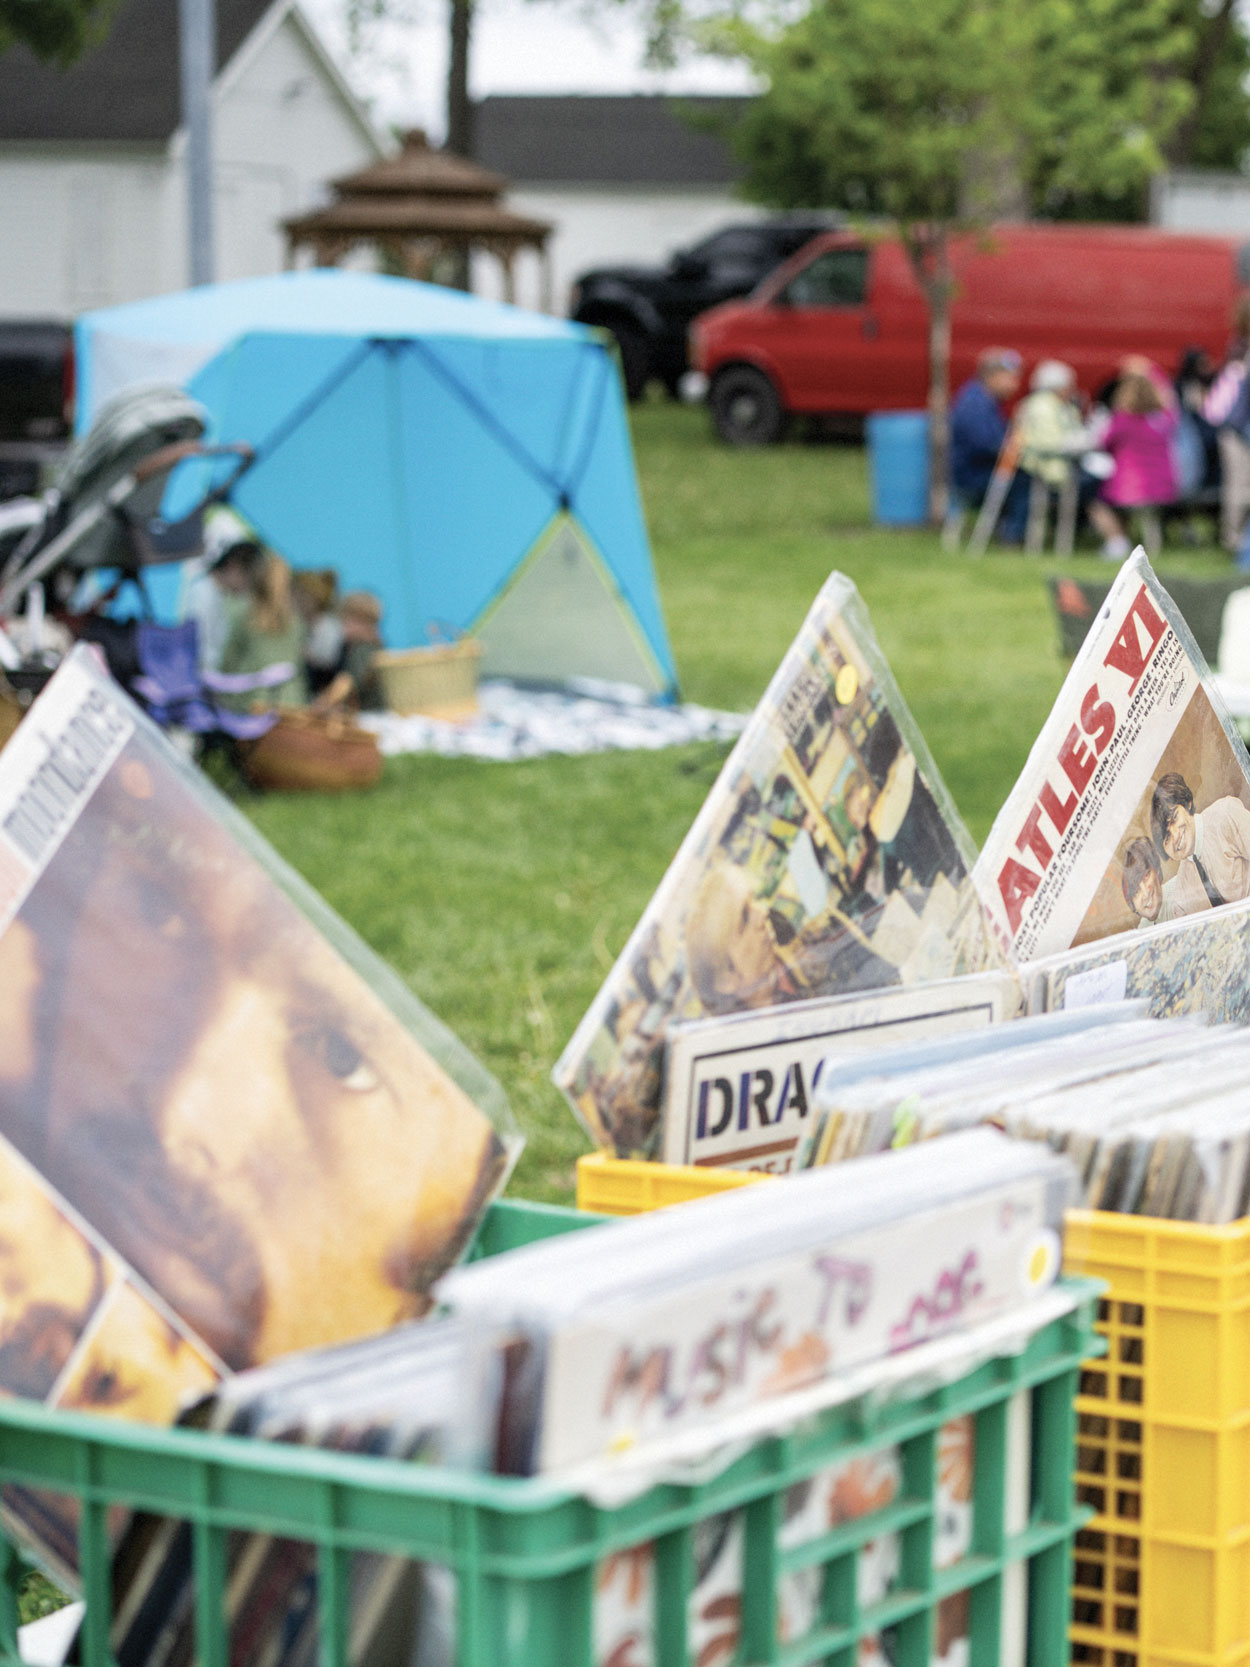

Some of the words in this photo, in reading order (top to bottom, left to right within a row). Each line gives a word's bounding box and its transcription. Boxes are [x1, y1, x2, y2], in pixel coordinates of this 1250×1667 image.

[985, 683, 1116, 948] ATLES
[1103, 583, 1168, 698] VI
[1028, 861, 1057, 920] POPULAR
[1056, 789, 1092, 860] FOURSOME!
[1091, 756, 1108, 791] JOHN
[1109, 724, 1125, 753] PAUL
[1126, 671, 1151, 719] GEORGE
[1151, 629, 1173, 669] RINGO
[1082, 826, 1090, 840] THE
[1089, 801, 1102, 826] PARTY
[1104, 771, 1117, 795] EVERY
[1116, 747, 1129, 771] LITTLE
[1129, 722, 1141, 746] THING
[1143, 696, 1155, 717] WHAT
[1154, 668, 1169, 695] YOU'RE
[1168, 644, 1182, 669] DOING
[1098, 775, 1108, 794] MISS
[1107, 752, 1119, 775] LIZZIE
[1121, 723, 1133, 746] EIGHT
[1133, 703, 1143, 723] DAYS
[1146, 676, 1157, 696] WEEK
[1159, 656, 1168, 670] YES
[1167, 646, 1173, 655] IT
[1172, 636, 1178, 646] IS
[695, 1057, 826, 1141] DRA
